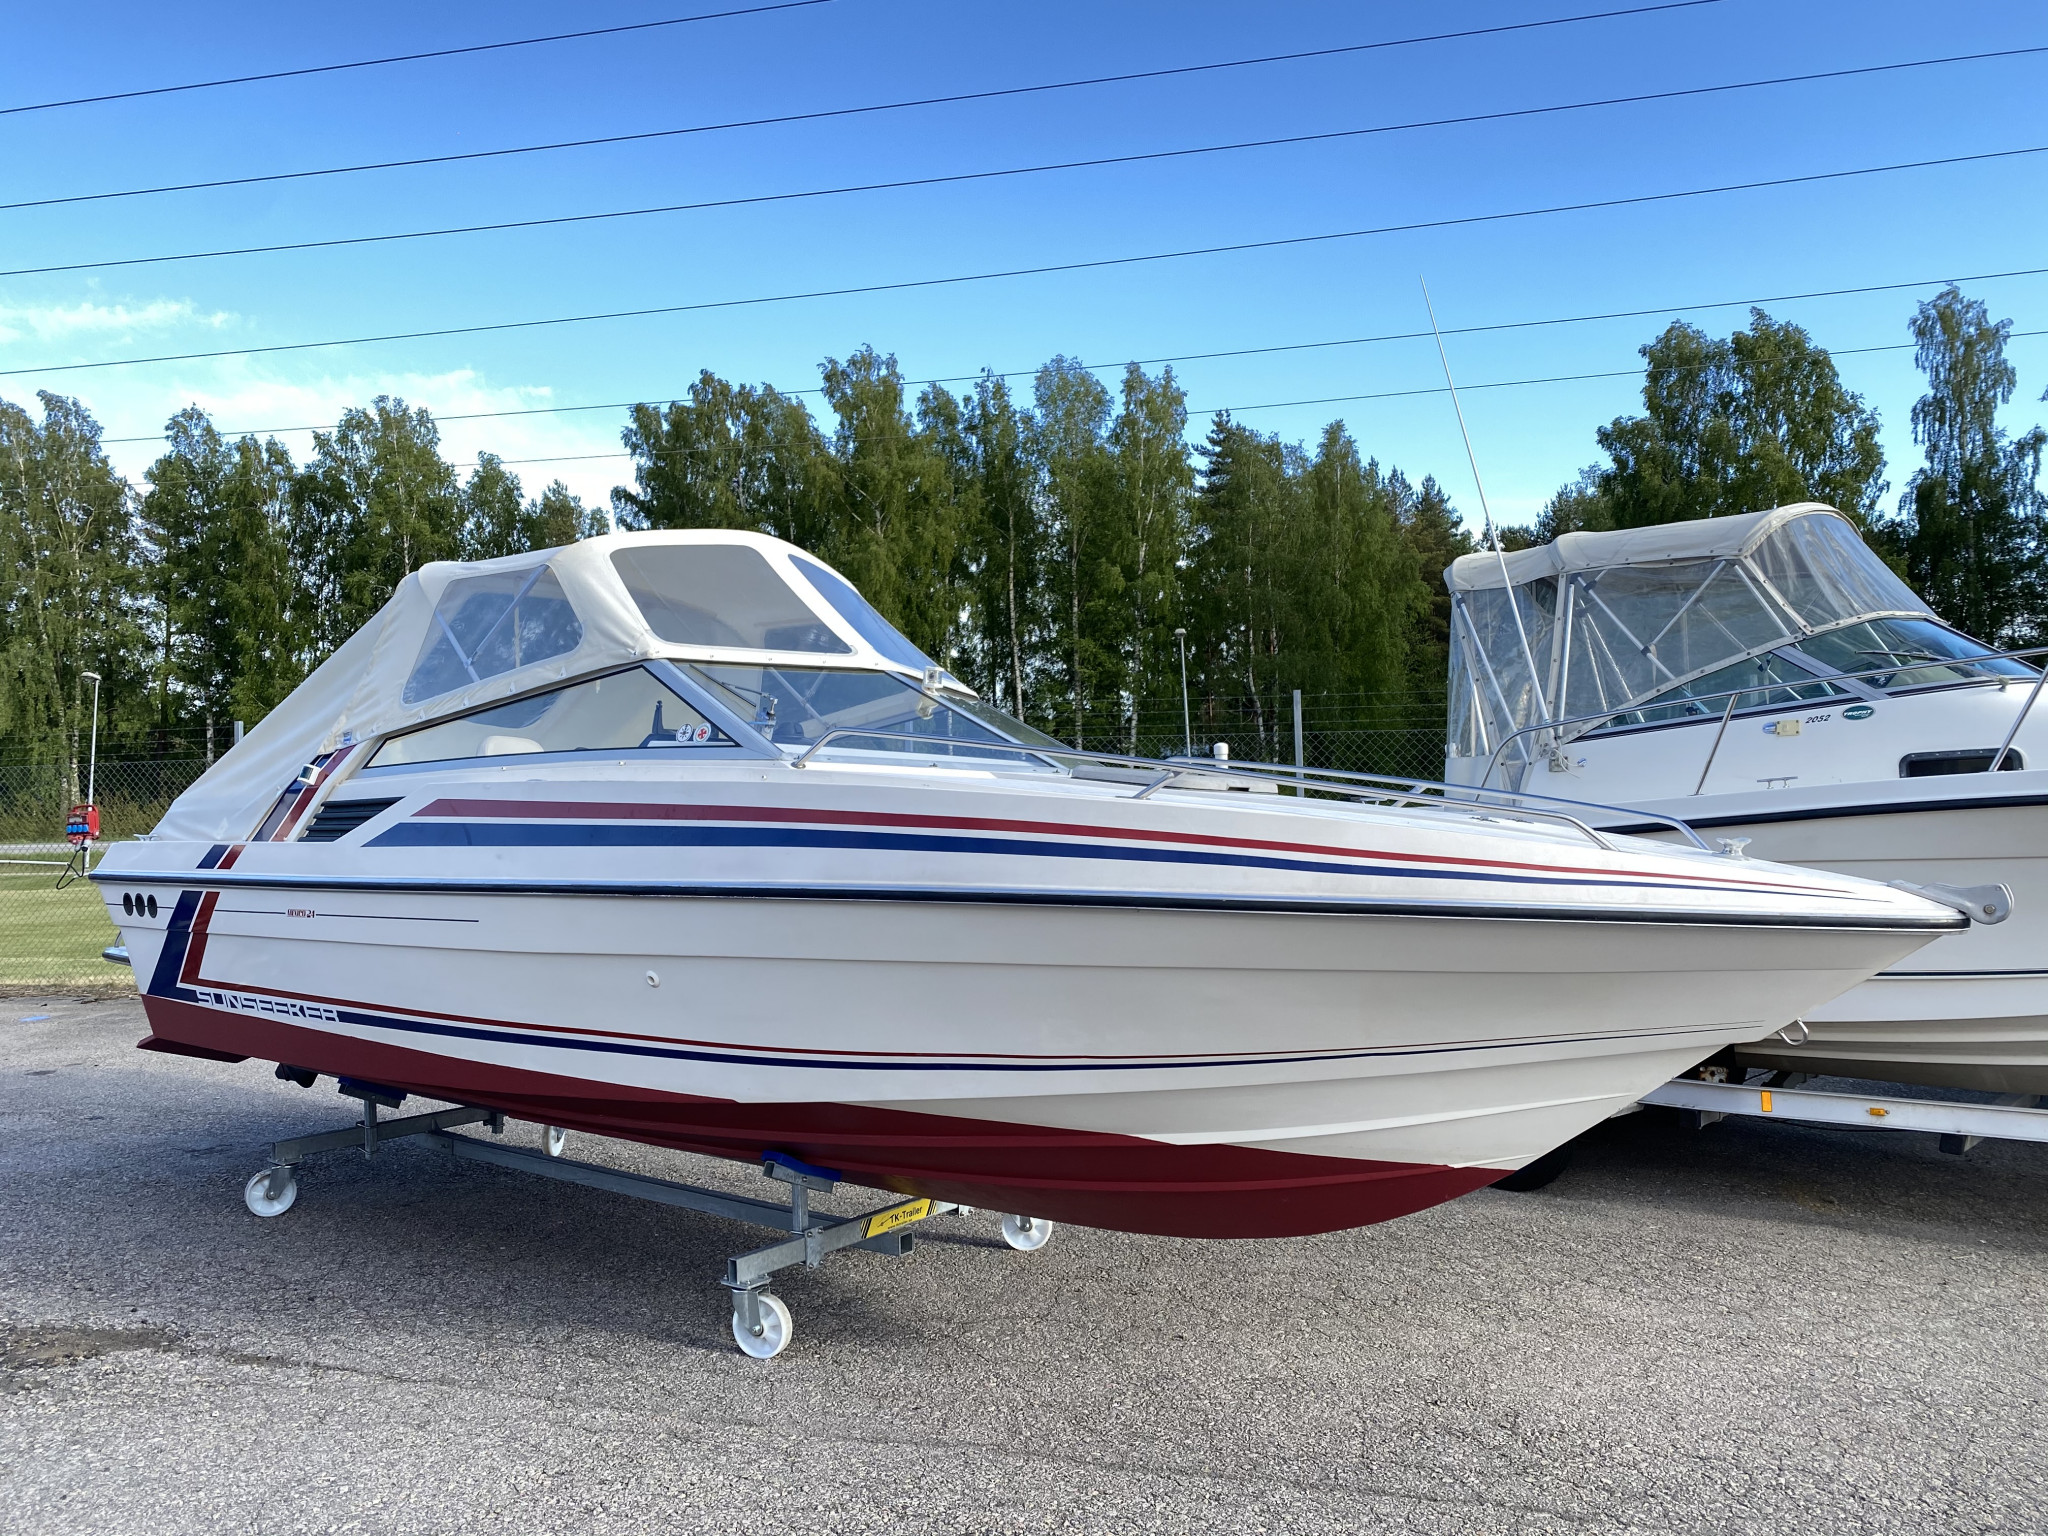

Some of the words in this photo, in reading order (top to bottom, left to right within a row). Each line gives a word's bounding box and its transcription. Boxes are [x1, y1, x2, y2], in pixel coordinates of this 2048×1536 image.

[1844, 709, 1873, 717] TROPHY
[1805, 714, 1832, 724] 2052
[306, 909, 315, 918] 24
[196, 991, 339, 1022] SUNSEEKER
[890, 1206, 923, 1224] TK-Trailer
